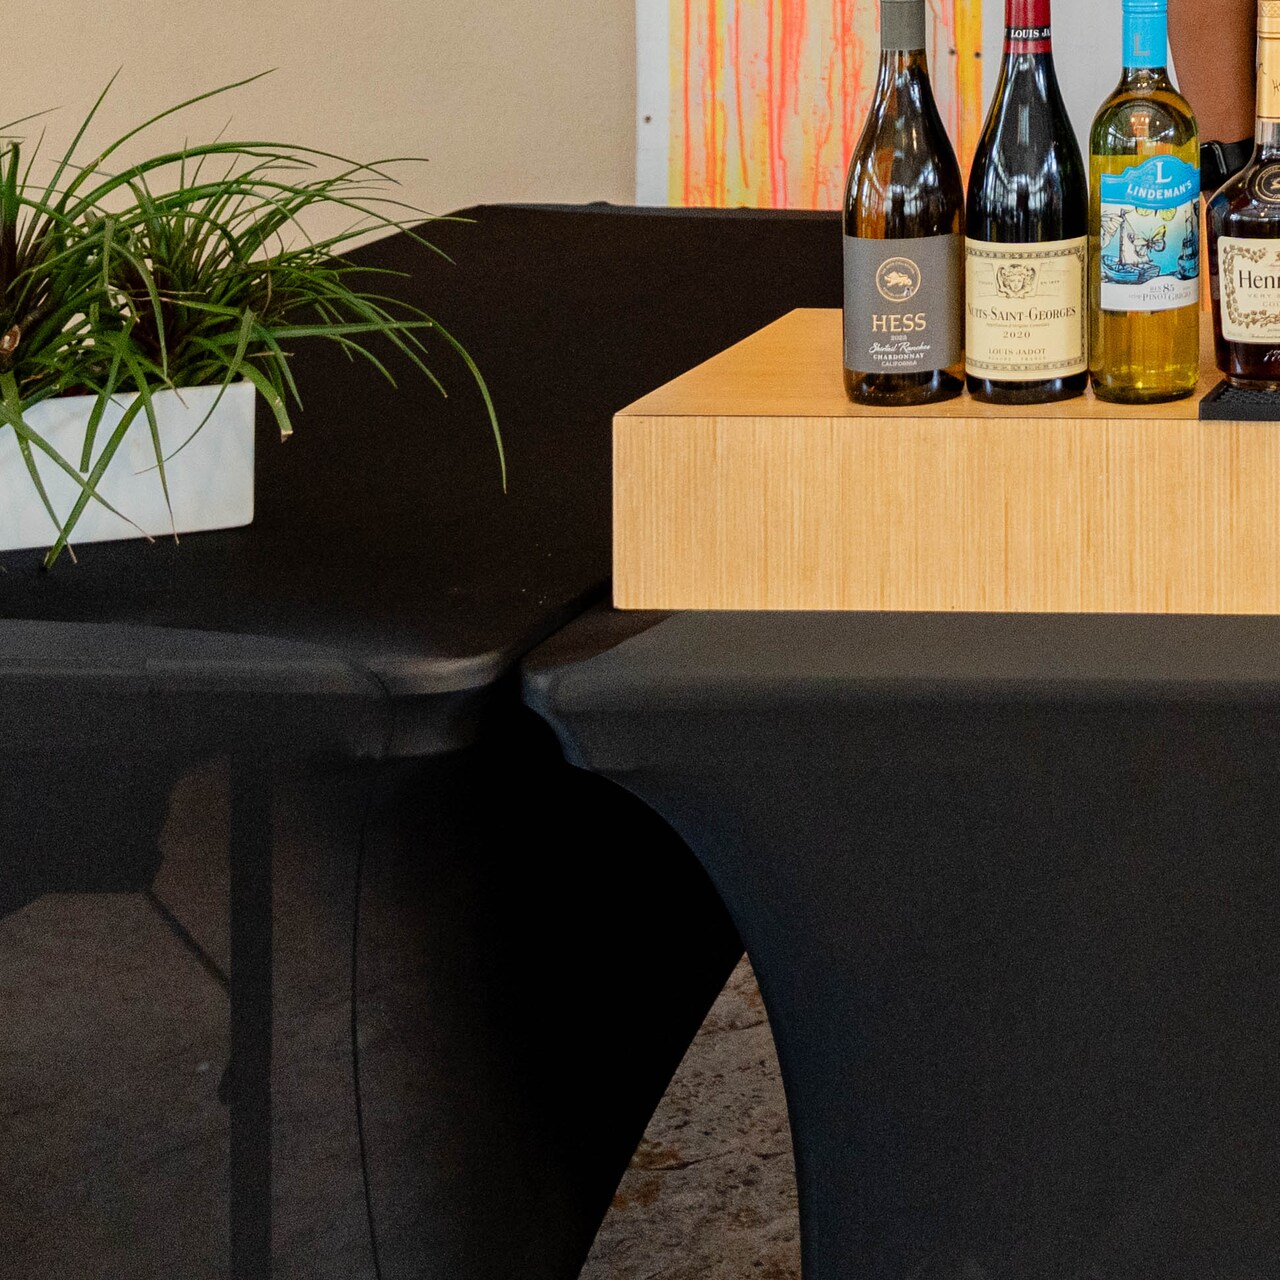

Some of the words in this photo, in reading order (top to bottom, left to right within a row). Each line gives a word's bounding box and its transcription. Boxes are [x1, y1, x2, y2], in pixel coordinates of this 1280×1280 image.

[1011, 29, 1040, 38] LOUIS
[1155, 161, 1172, 183] L
[1127, 180, 1192, 200] LINDEMAN'S
[1163, 283, 1175, 293] 85
[1143, 293, 1168, 302] PINOT
[872, 313, 927, 332] HESS
[1003, 331, 1031, 339] 2020
[1016, 348, 1046, 356] JADOT
[873, 353, 925, 361] CHARDONNAY
